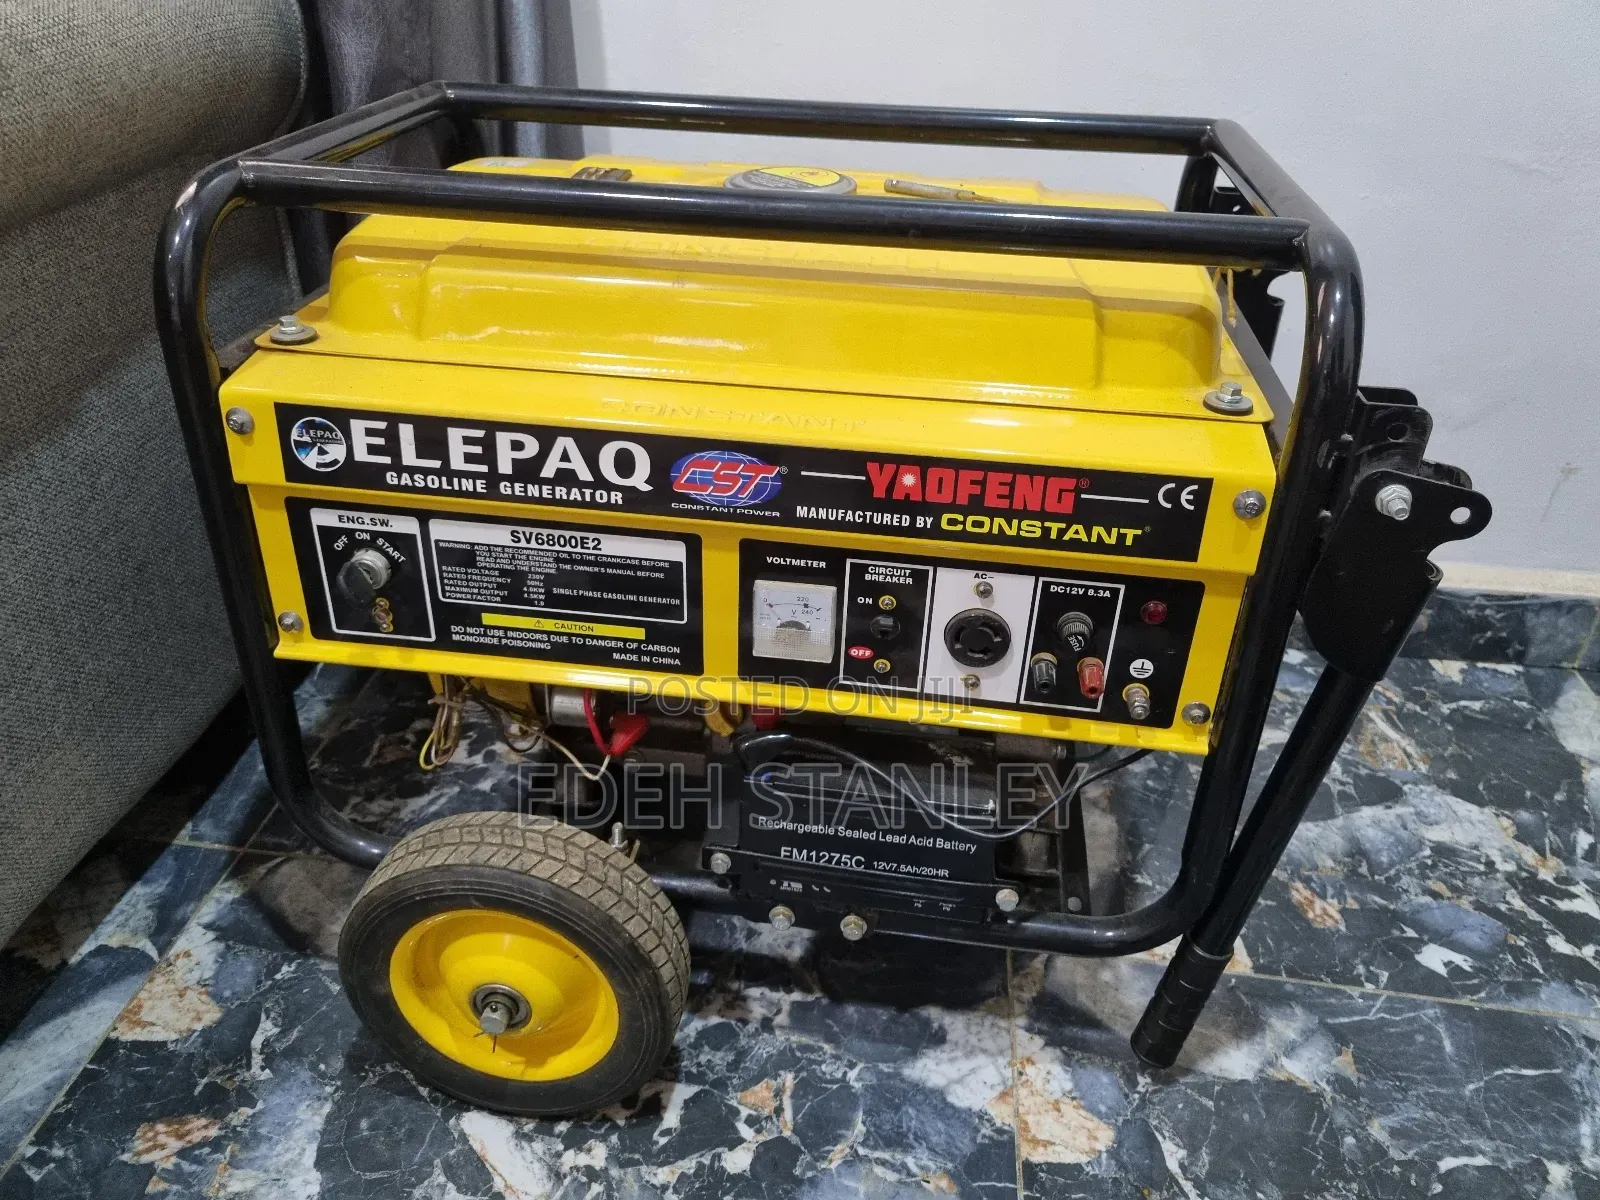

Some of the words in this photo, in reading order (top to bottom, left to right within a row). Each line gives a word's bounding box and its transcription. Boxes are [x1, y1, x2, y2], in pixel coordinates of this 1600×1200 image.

[349, 418, 654, 492] ELEPAQ
[672, 458, 780, 498] CST
[385, 471, 488, 493] GASOLINE
[499, 481, 624, 505] GENERATOR
[866, 461, 1079, 514] YAOFENG
[671, 502, 734, 514] CONSTANT
[736, 508, 781, 518] POWER
[796, 505, 911, 528] MANUFACTURED
[915, 515, 934, 529] BY
[337, 514, 393, 528] ENG.SW.
[355, 531, 370, 540] ON
[940, 513, 1143, 546] CONSTANT
[333, 535, 349, 551] OFF
[510, 529, 602, 551] SV6800E2
[376, 537, 407, 563] START
[439, 541, 473, 550] WARNING:
[504, 547, 558, 558] RECOMMENDED
[559, 551, 570, 559] OIL
[597, 555, 640, 565] CRANKCASE
[641, 559, 670, 568] BEFORE
[491, 551, 513, 559] START
[442, 565, 466, 573] RATED
[467, 567, 500, 576] VOLTAGE
[476, 561, 515, 571] OPERATING
[517, 564, 530, 572] THE
[512, 558, 557, 569] UNDERSTAND
[573, 564, 605, 573] OWNER'S
[606, 567, 635, 576] MANUAL
[637, 570, 665, 579] BEFORE
[766, 556, 827, 569] VOLTMETER
[443, 572, 466, 580] RATED
[467, 574, 512, 584] FREQUENCY
[864, 573, 913, 585] BREAKER
[867, 566, 912, 577] CIRCUIT
[444, 578, 467, 587] RATED
[468, 581, 497, 589] OUTPUT
[445, 585, 479, 594] MAXIMUM
[480, 588, 508, 597] OUTPUT
[1049, 583, 1085, 595] DC12V
[1087, 588, 1111, 598] 8.3A
[446, 592, 472, 600] POWER
[473, 594, 502, 602] FACTOR
[552, 587, 578, 596] SINGLE
[578, 589, 602, 598] PHASE
[602, 592, 638, 602] GASOLINE
[638, 595, 681, 606] GENERATOR
[857, 596, 873, 605] ON
[553, 621, 595, 633] CAUTION
[450, 625, 465, 634] DO
[466, 626, 485, 636] NOT
[486, 627, 506, 637] USE
[507, 629, 549, 641] INDOORS
[550, 634, 569, 644] DUE
[571, 635, 584, 645] TO
[585, 637, 623, 649] DANGER
[626, 640, 639, 650] OF
[640, 642, 681, 654] CARBON
[451, 633, 501, 645] MONOXIDE
[501, 637, 552, 650] POISONING
[1067, 634, 1082, 652] FUSE
[612, 651, 639, 662] MADE
[641, 654, 651, 663] IN
[652, 655, 682, 666] CHINA
[850, 648, 871, 657] OFF
[758, 816, 836, 836] Rechargeable
[837, 826, 877, 841] Sealed
[878, 831, 907, 844] Lead
[908, 835, 934, 848] Acid
[935, 838, 978, 854] Battery
[872, 860, 950, 878] 12V7.5Ah/20HR
